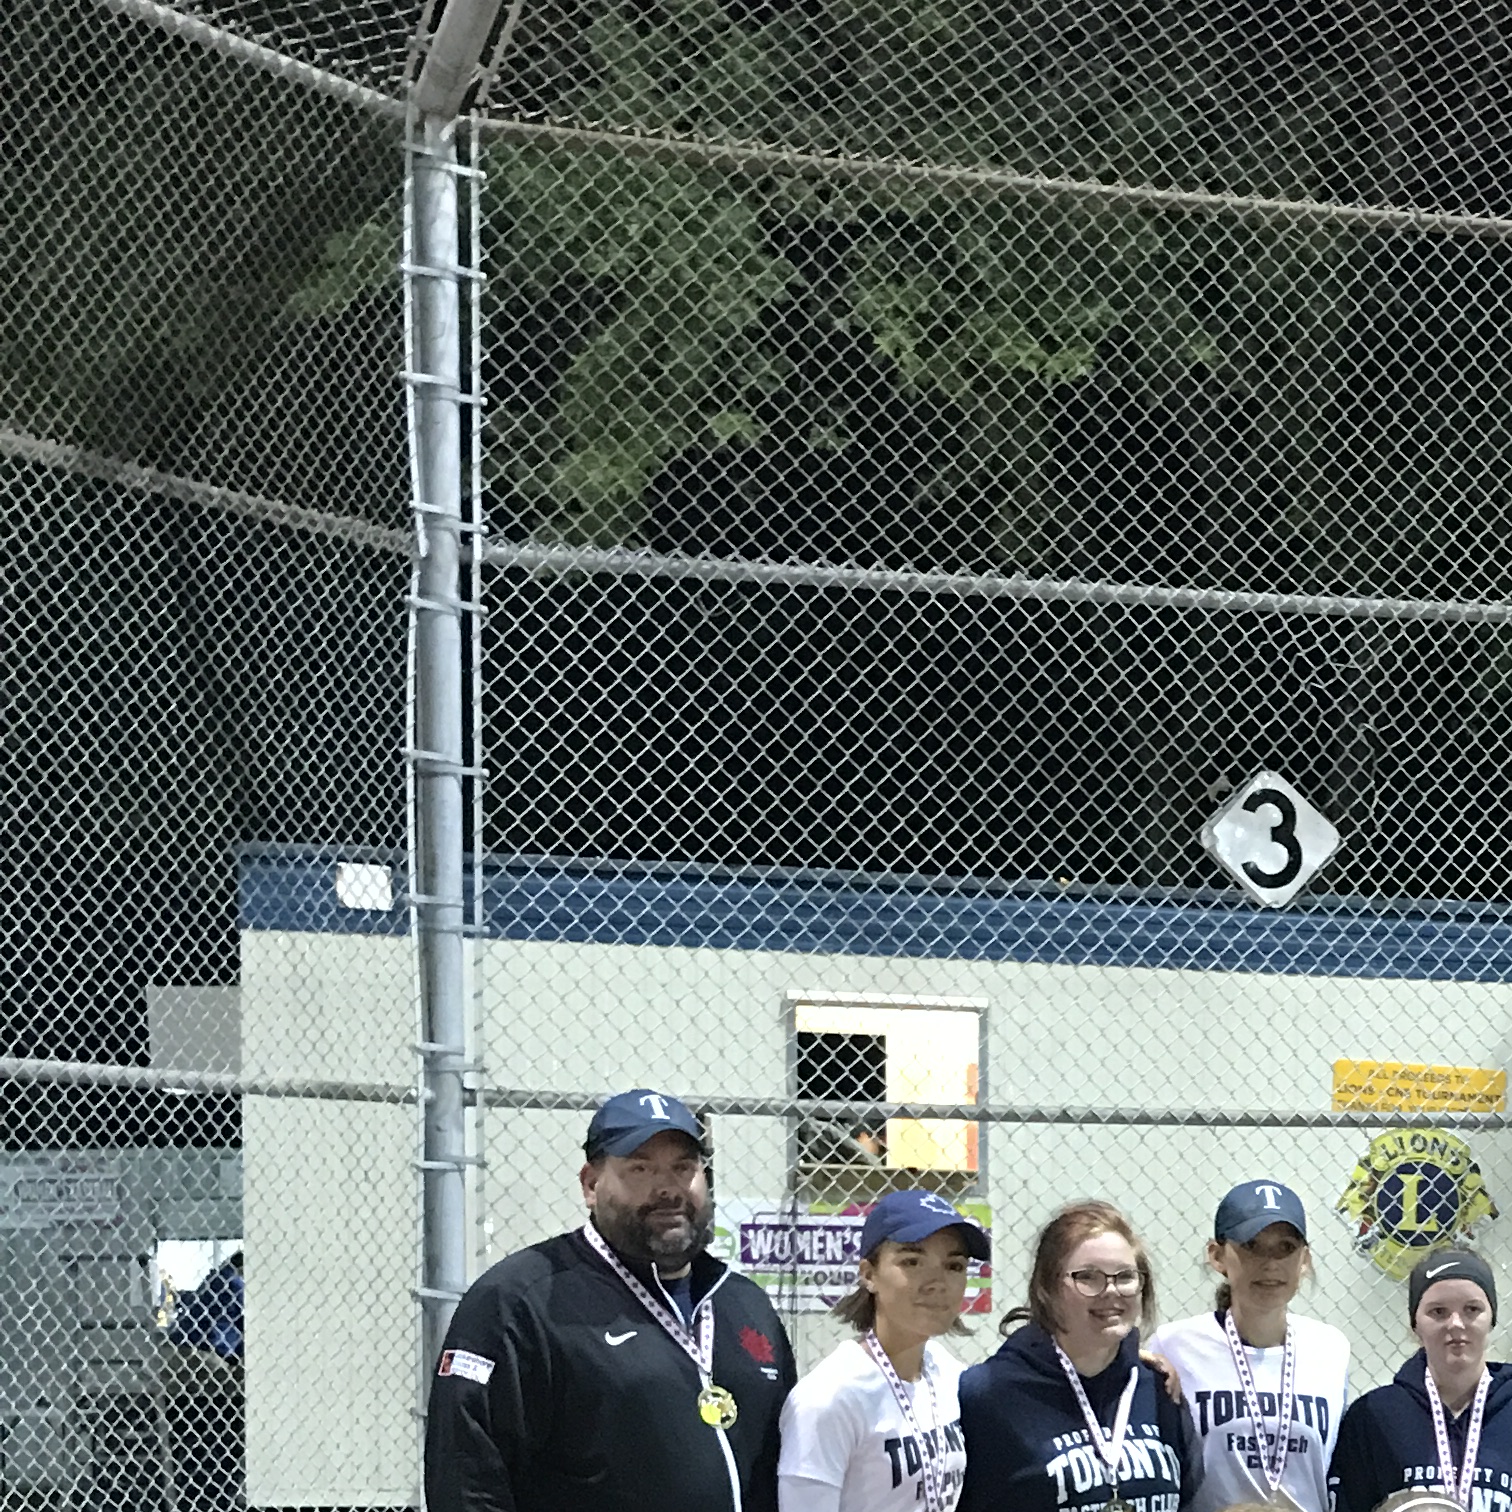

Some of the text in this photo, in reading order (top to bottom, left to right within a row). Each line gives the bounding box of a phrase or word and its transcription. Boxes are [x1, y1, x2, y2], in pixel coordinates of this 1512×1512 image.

[1241, 788, 1303, 889] 3
[639, 1094, 670, 1120] T
[1380, 1134, 1463, 1167] LIONS
[1255, 1185, 1282, 1210] T
[1396, 1173, 1439, 1231] L
